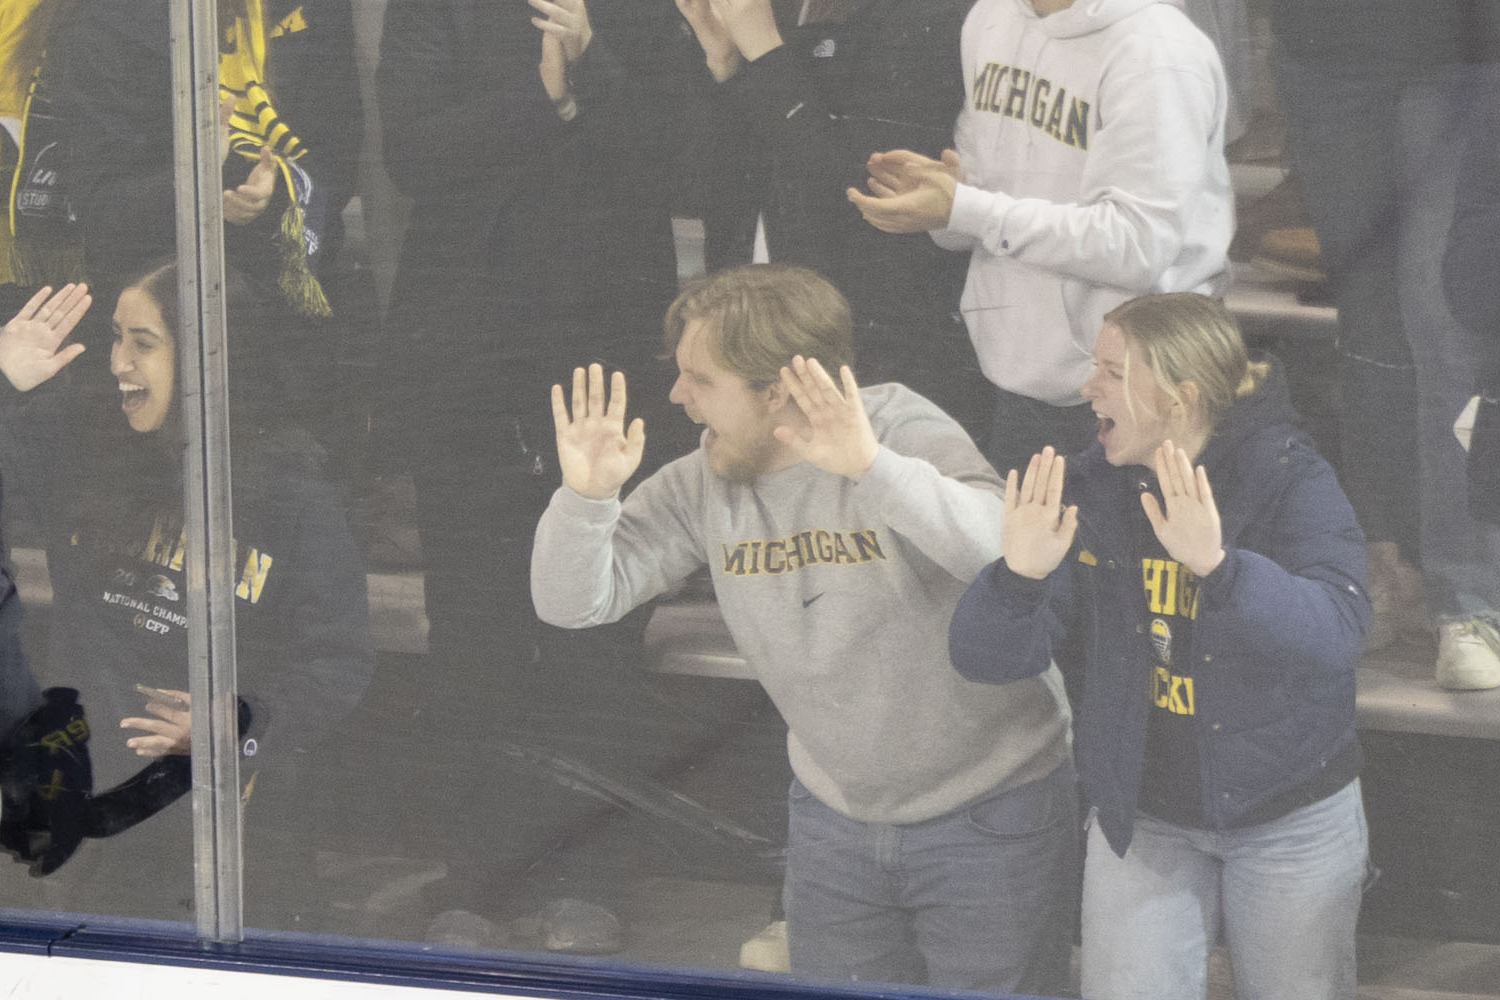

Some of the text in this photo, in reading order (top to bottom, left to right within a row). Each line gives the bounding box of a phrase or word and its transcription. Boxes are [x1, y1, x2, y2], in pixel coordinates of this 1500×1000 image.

[974, 62, 1091, 152] MICHGAN
[721, 529, 888, 577] MICHIGAN
[153, 605, 189, 630] CHAMP
